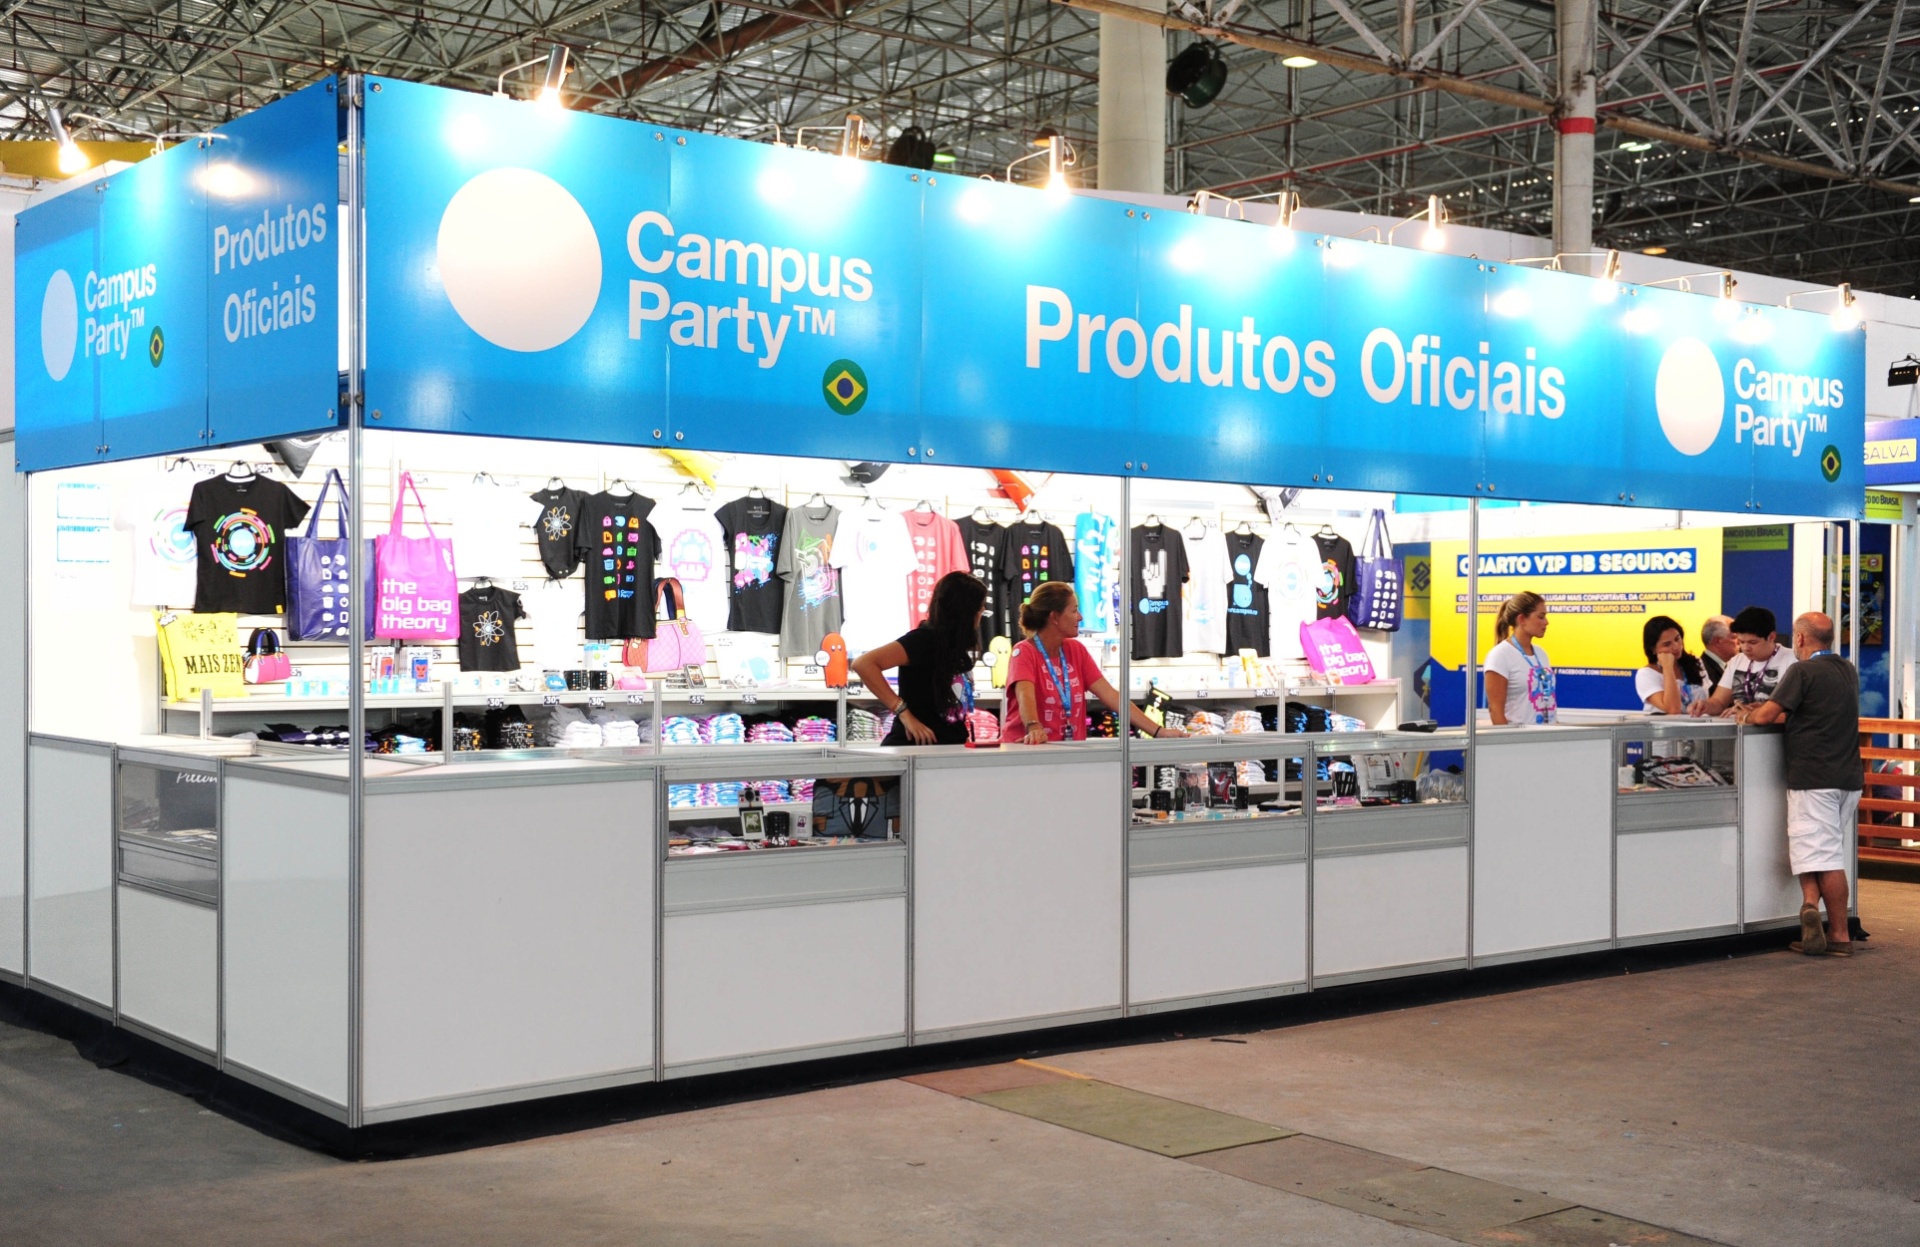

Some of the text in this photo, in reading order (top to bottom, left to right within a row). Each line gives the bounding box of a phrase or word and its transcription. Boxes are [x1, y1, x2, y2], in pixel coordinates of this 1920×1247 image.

[214, 203, 327, 275] Produtos
[626, 211, 874, 303] Campus
[84, 263, 157, 313] Campus
[223, 276, 316, 343] Oficiais
[1025, 284, 1566, 419] Produtos Oficiais
[1734, 358, 1844, 412] Campus
[1745, 529, 1756, 537] DO
[1757, 527, 1784, 536] BRASIL
[1533, 555, 1567, 574] VIP
[1570, 555, 1596, 573] BB
[1599, 550, 1693, 573] SEGUROS
[382, 578, 417, 595] the
[1628, 592, 1638, 600] DA
[1638, 592, 1667, 600] CAMPUS
[381, 597, 453, 615] big bag
[381, 614, 446, 632] theory
[1319, 644, 1342, 656] the
[1323, 652, 1368, 667] big bag
[184, 654, 221, 674] MAIS
